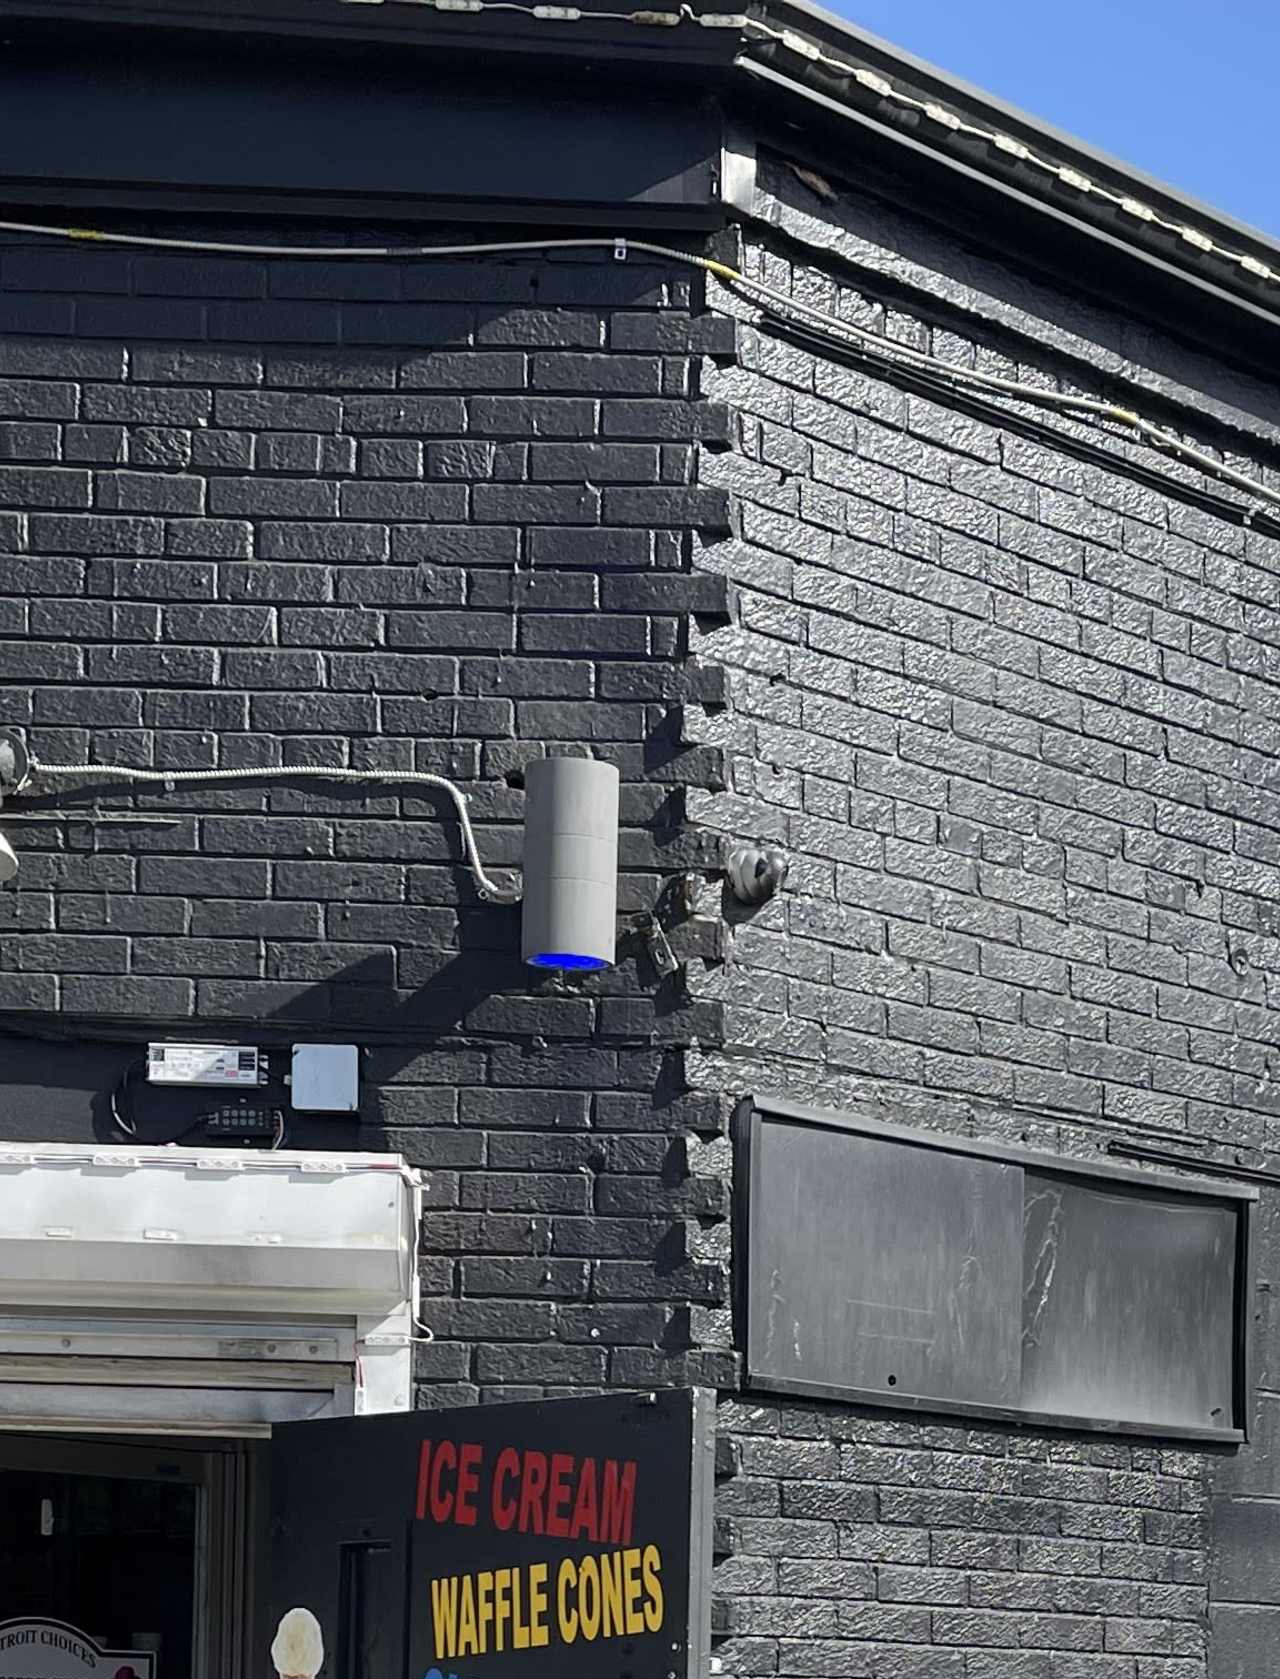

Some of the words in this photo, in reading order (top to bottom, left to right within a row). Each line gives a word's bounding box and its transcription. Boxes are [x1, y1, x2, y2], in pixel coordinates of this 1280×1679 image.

[415, 1439, 484, 1528] ICE
[491, 1446, 638, 1546] CREAM
[40, 1630, 97, 1669] CHOICES
[431, 1561, 550, 1660] WAFFLE
[556, 1543, 665, 1644] CONES
